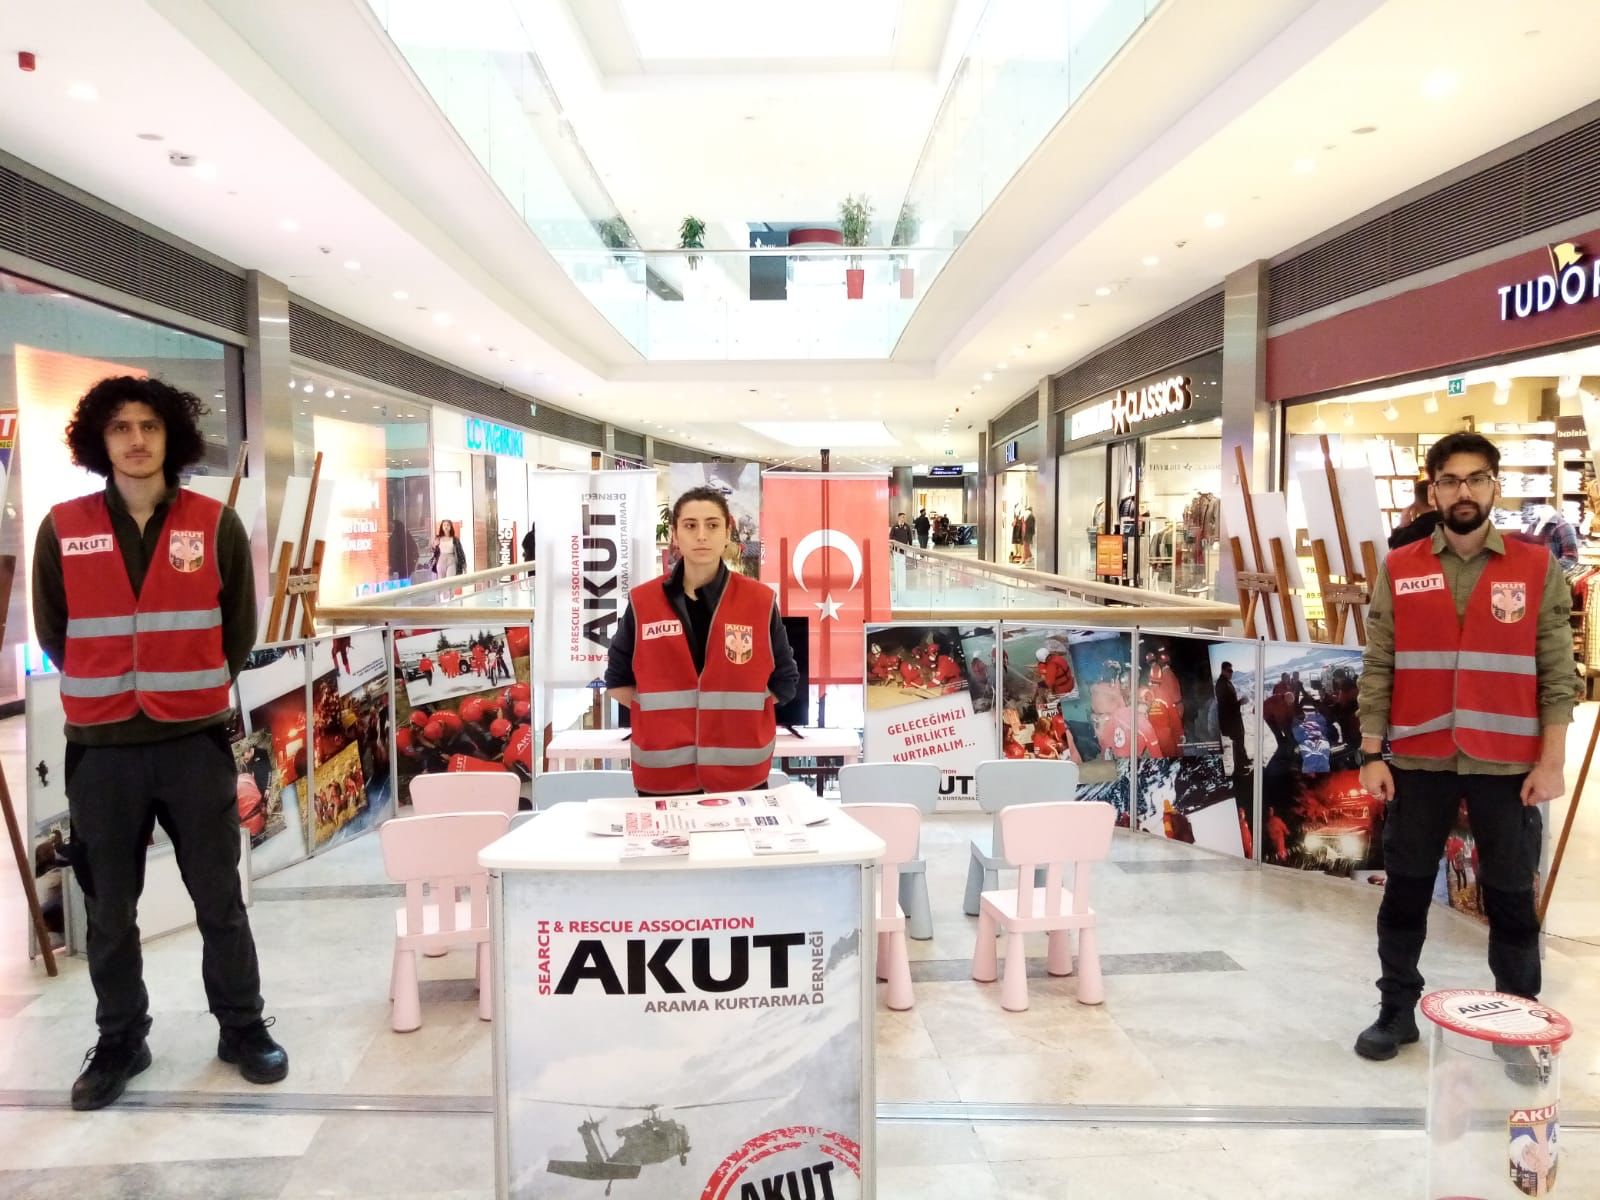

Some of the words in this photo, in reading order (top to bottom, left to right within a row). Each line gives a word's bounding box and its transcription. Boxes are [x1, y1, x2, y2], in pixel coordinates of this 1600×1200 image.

[1125, 376, 1185, 424] CLASSICS
[173, 530, 204, 538] AKUT
[619, 501, 629, 559] KURTARMA
[67, 538, 109, 552] AKUT
[571, 535, 580, 604] ASSOCIATION
[581, 504, 618, 649] AKUT
[1400, 577, 1440, 592] AKUT
[571, 607, 580, 643] RESCUE
[646, 623, 680, 637] AKUT
[727, 624, 752, 632] AKUT
[570, 654, 610, 662] EARCH
[887, 706, 967, 736] GELECEĞİMİZİ
[904, 726, 957, 747] BİRLİKTE
[938, 776, 974, 795] UT
[553, 921, 565, 933] &
[569, 921, 633, 933] RESCUE
[638, 917, 755, 932] ASSOCIATION
[537, 920, 551, 996] SEARCH
[553, 932, 806, 995] AKUT
[809, 930, 824, 1005] DERNEĞİ
[644, 999, 710, 1013] ARAMA
[714, 993, 810, 1011] KURTARMA
[1458, 1001, 1510, 1015] AKUT
